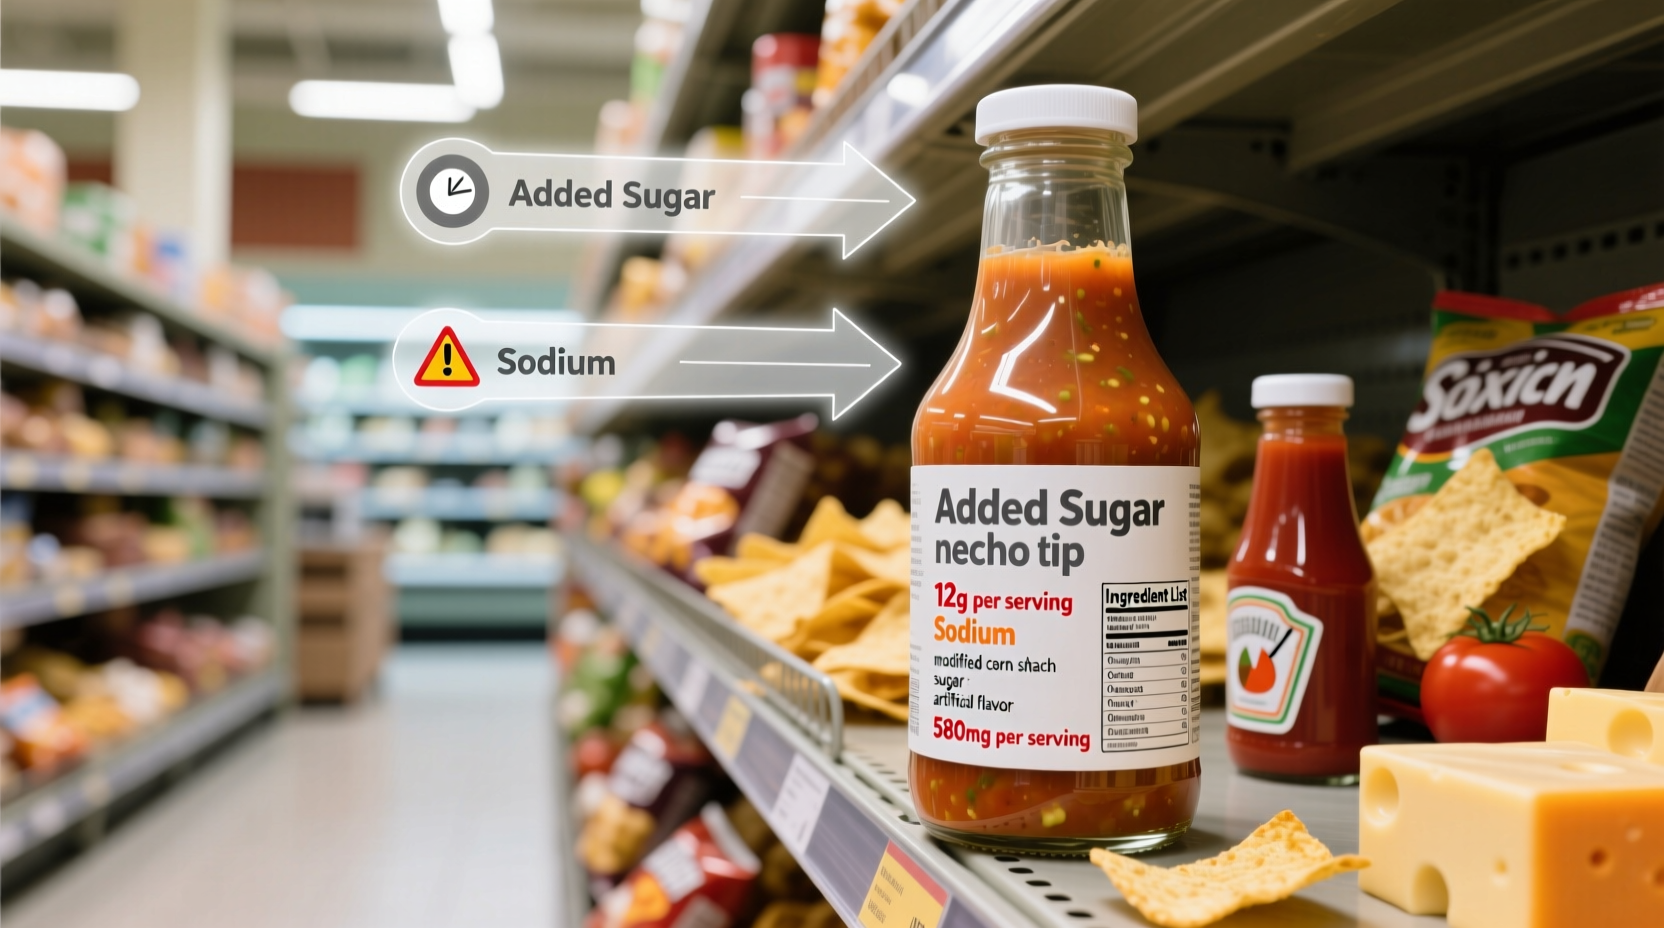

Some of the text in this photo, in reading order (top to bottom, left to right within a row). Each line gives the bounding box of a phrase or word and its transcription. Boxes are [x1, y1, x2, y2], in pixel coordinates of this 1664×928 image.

[934, 487, 1166, 538] Added Sugar
[935, 531, 1085, 577] necho tip
[933, 581, 1074, 618] 12g per serving
[933, 614, 1016, 646] Sodium
[977, 694, 1015, 713] flavor
[933, 715, 991, 749] 580mg
[995, 731, 1024, 749] per
[1027, 728, 1091, 753] serving
